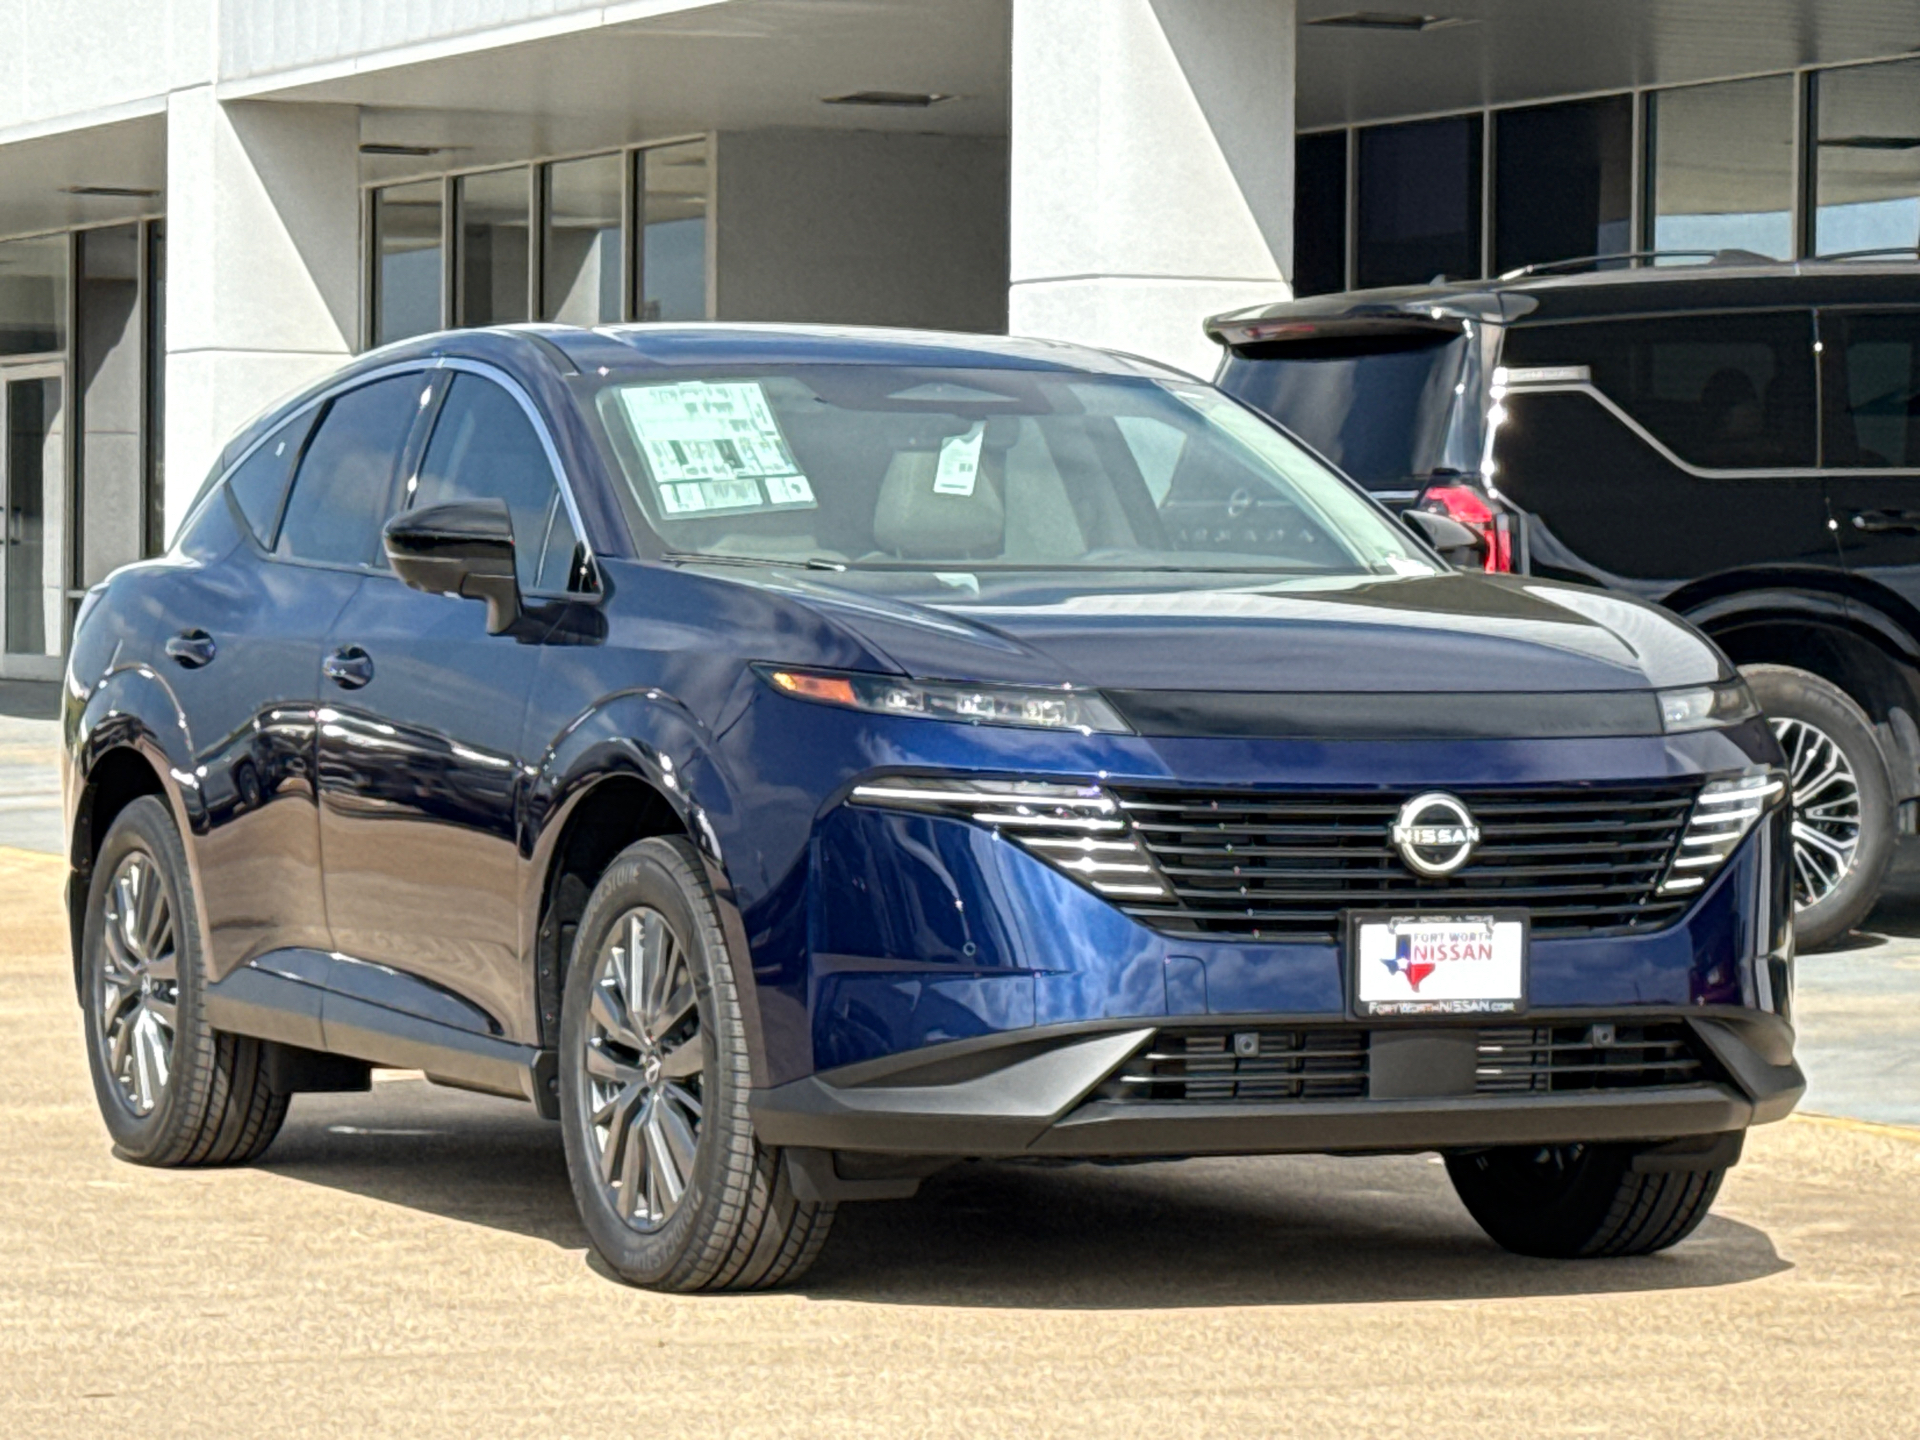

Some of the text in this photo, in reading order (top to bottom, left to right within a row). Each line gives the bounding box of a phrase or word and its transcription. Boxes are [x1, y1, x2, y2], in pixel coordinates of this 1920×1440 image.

[1393, 825, 1480, 843] NISSAN
[1414, 932, 1493, 943] FORT WORTH
[1414, 943, 1493, 962] NISSAN
